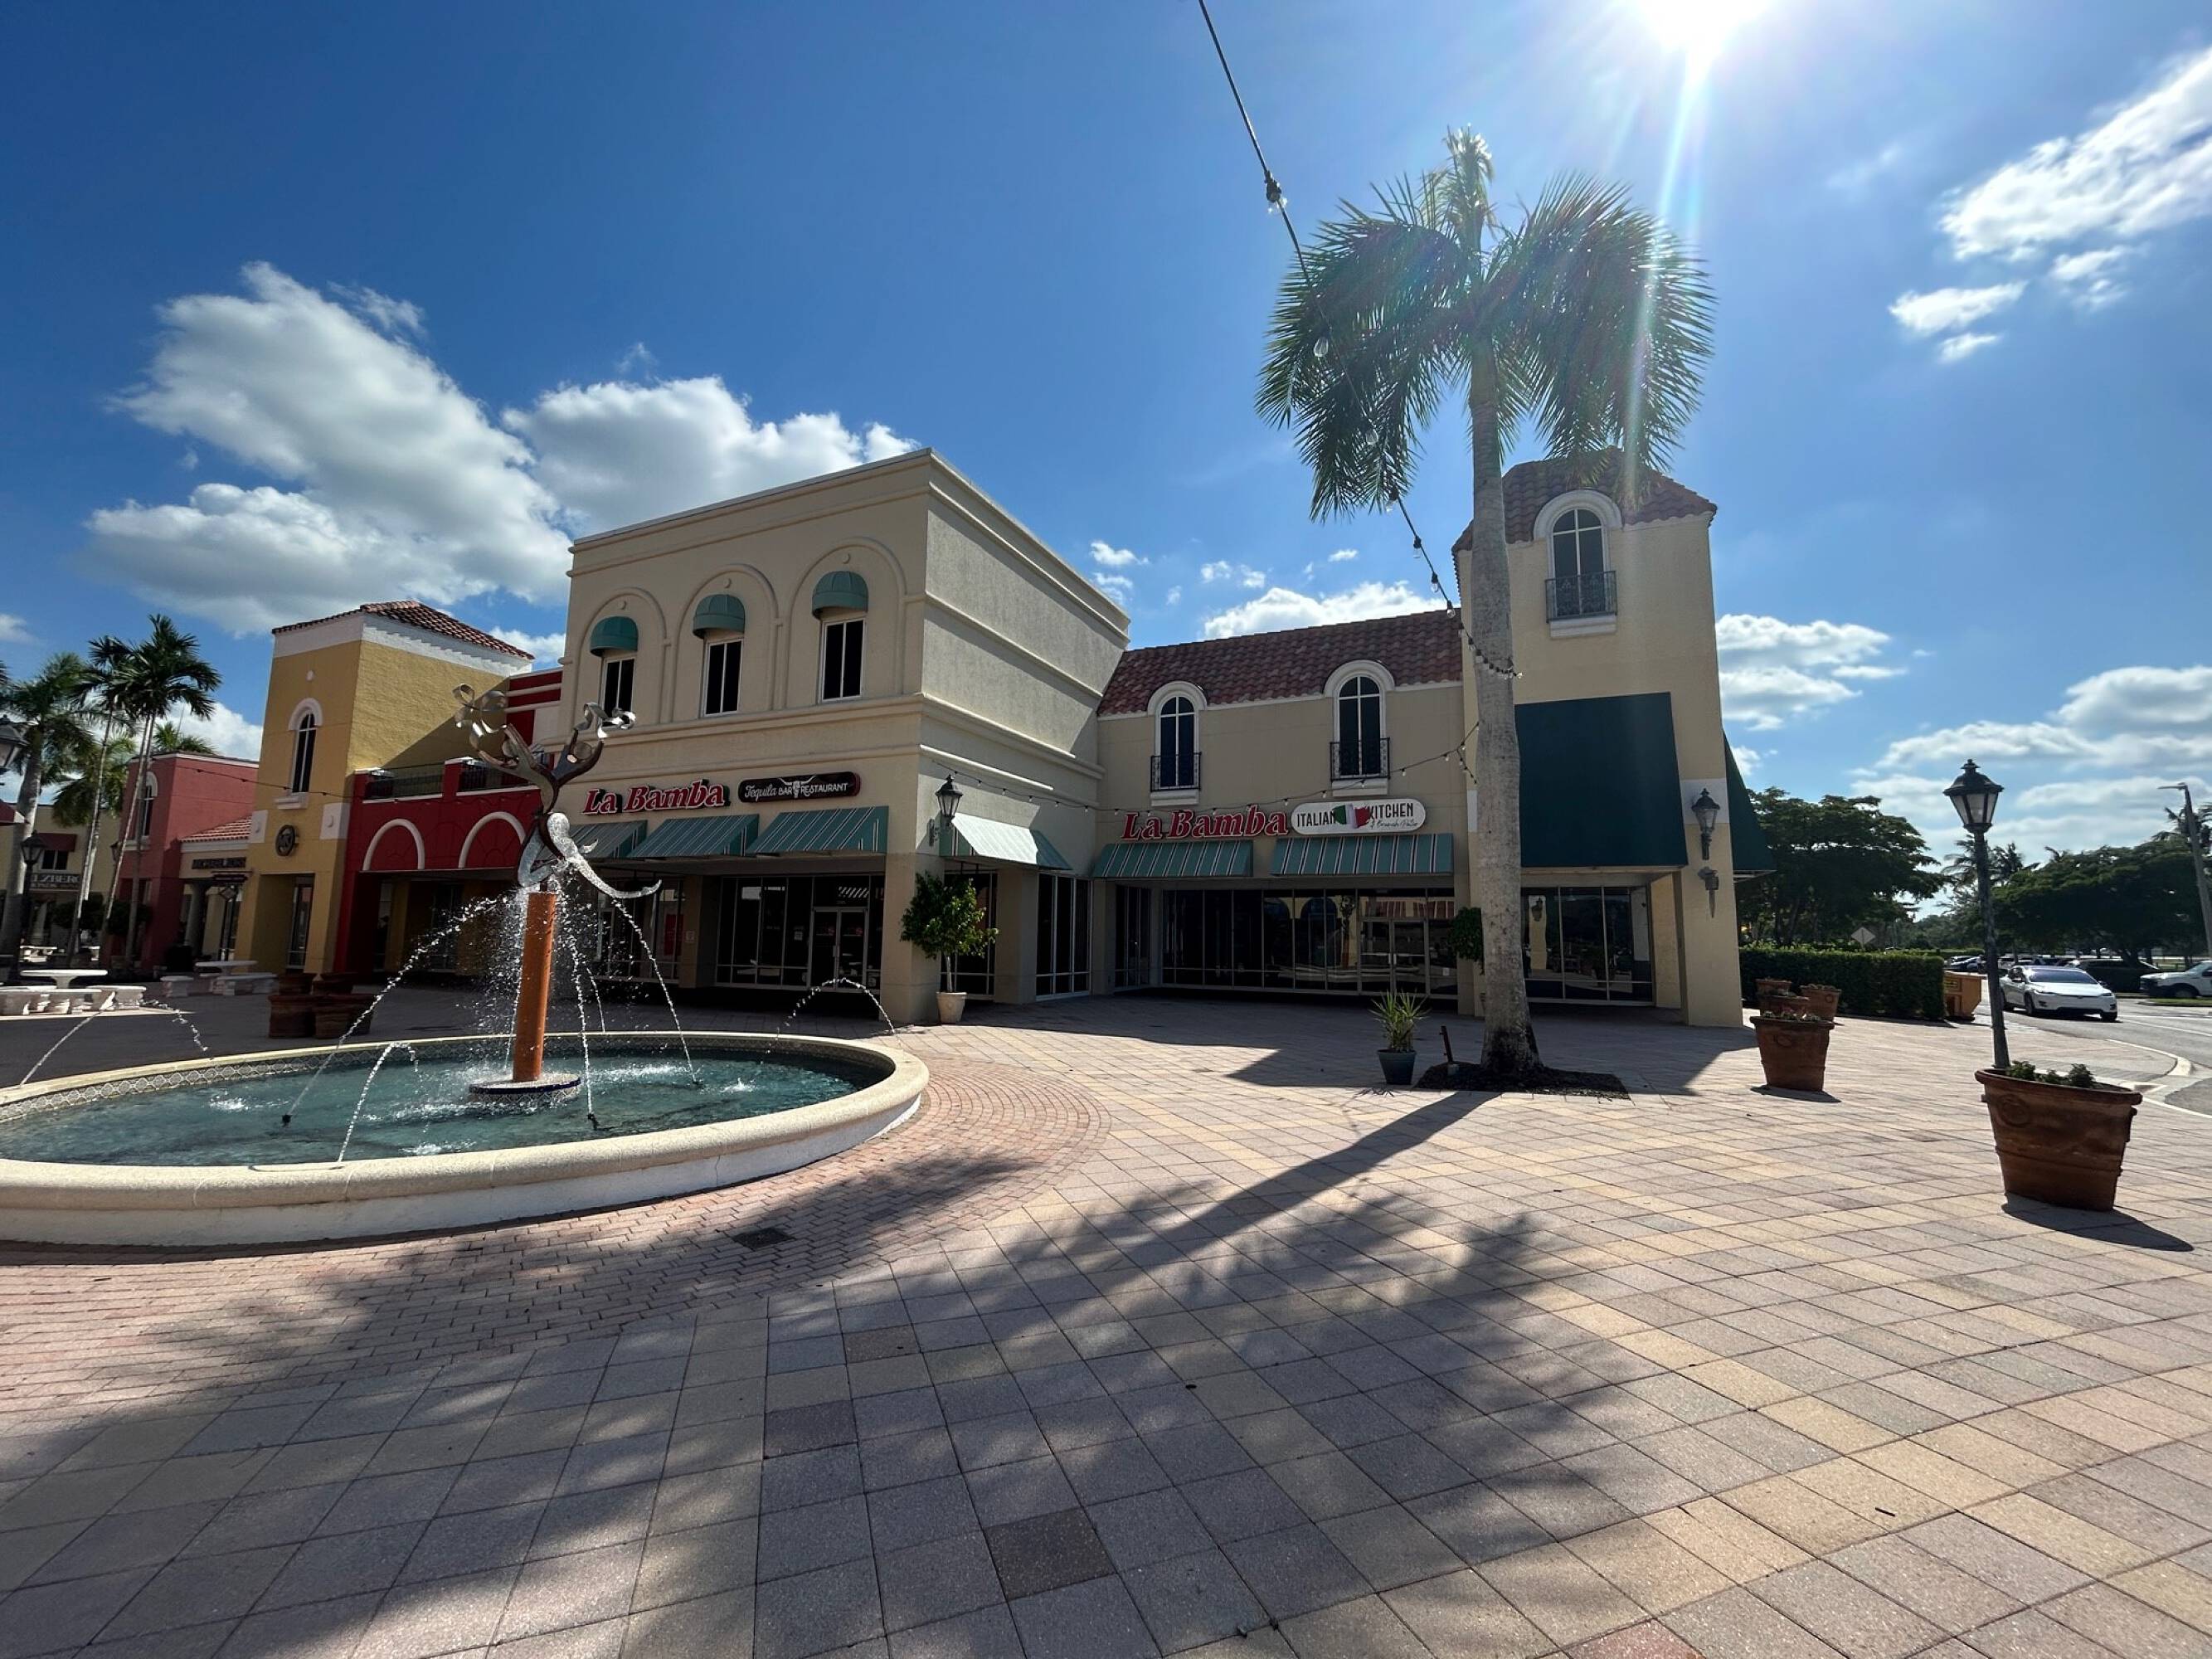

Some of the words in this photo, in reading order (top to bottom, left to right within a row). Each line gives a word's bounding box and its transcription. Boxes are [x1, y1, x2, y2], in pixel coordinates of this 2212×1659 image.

[582, 788, 619, 815] La
[623, 779, 726, 811] Bamba
[744, 783, 776, 802] Tequila
[778, 786, 793, 796] BAR
[800, 782, 849, 797] RESTAURANT
[1121, 810, 1161, 841] La
[1167, 804, 1290, 839] Bamba
[1296, 809, 1336, 827] ITALIAN
[1368, 802, 1414, 820] KITCHEN
